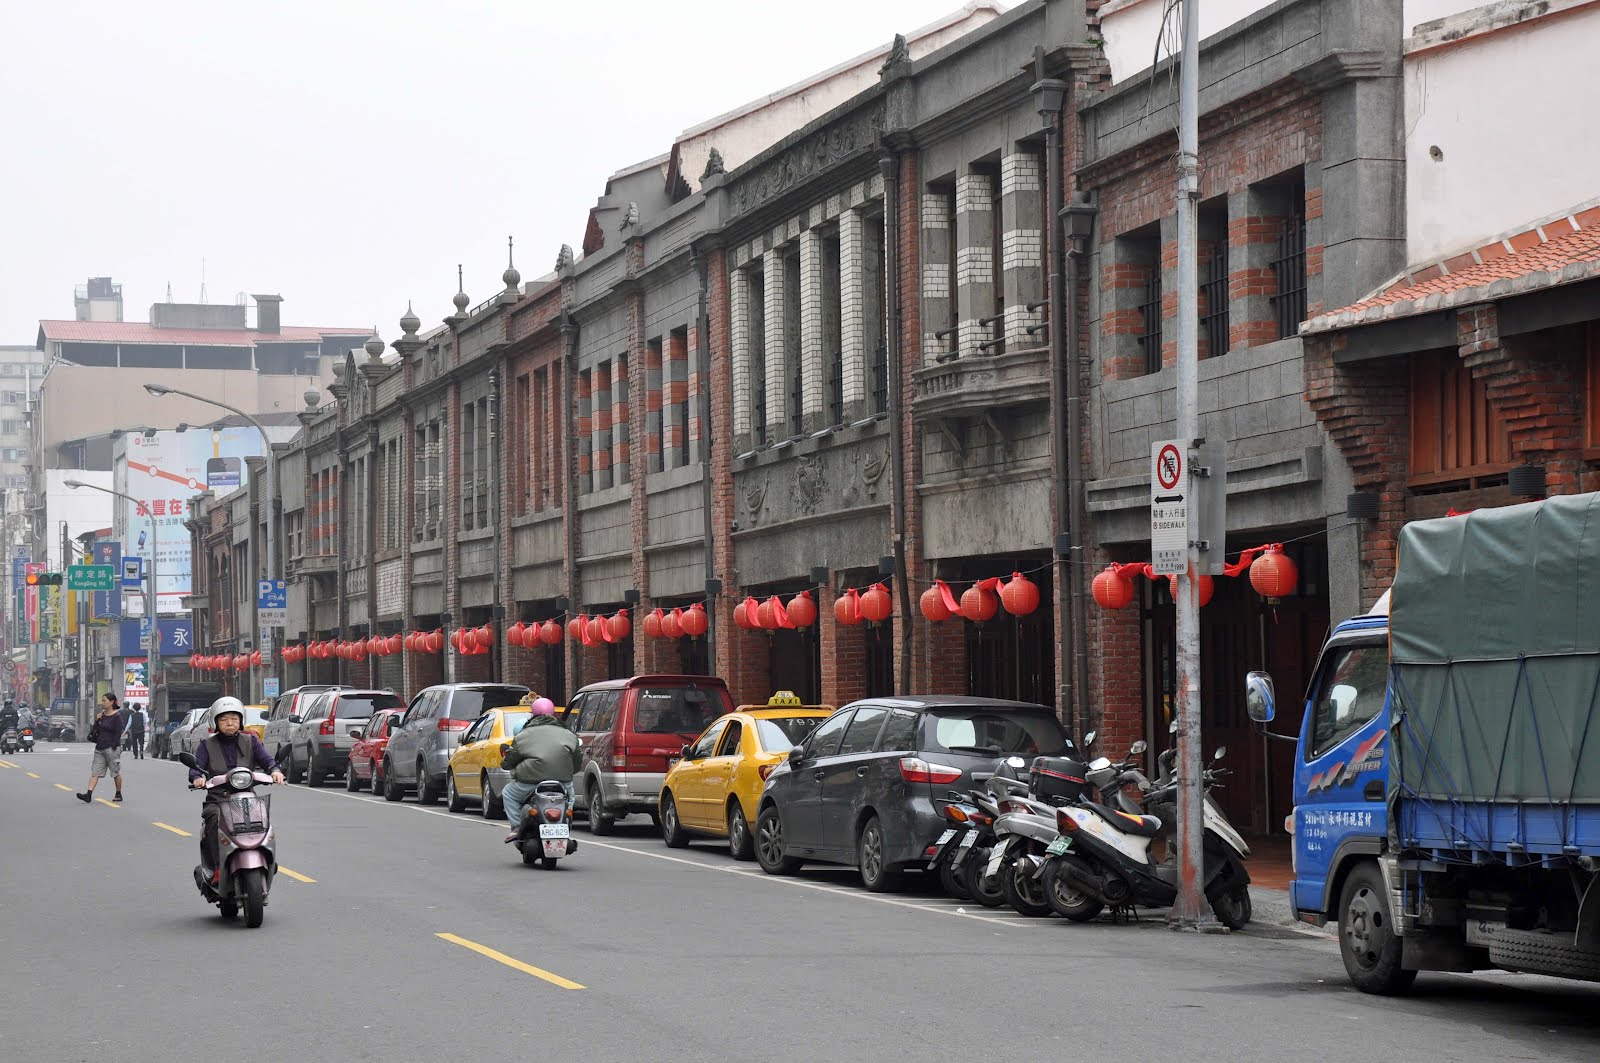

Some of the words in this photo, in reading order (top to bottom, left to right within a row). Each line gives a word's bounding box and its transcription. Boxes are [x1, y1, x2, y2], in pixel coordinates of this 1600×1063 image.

[136, 499, 190, 516] 永豐在
[1158, 521, 1185, 529] SIDEWALK
[174, 628, 189, 646] 永
